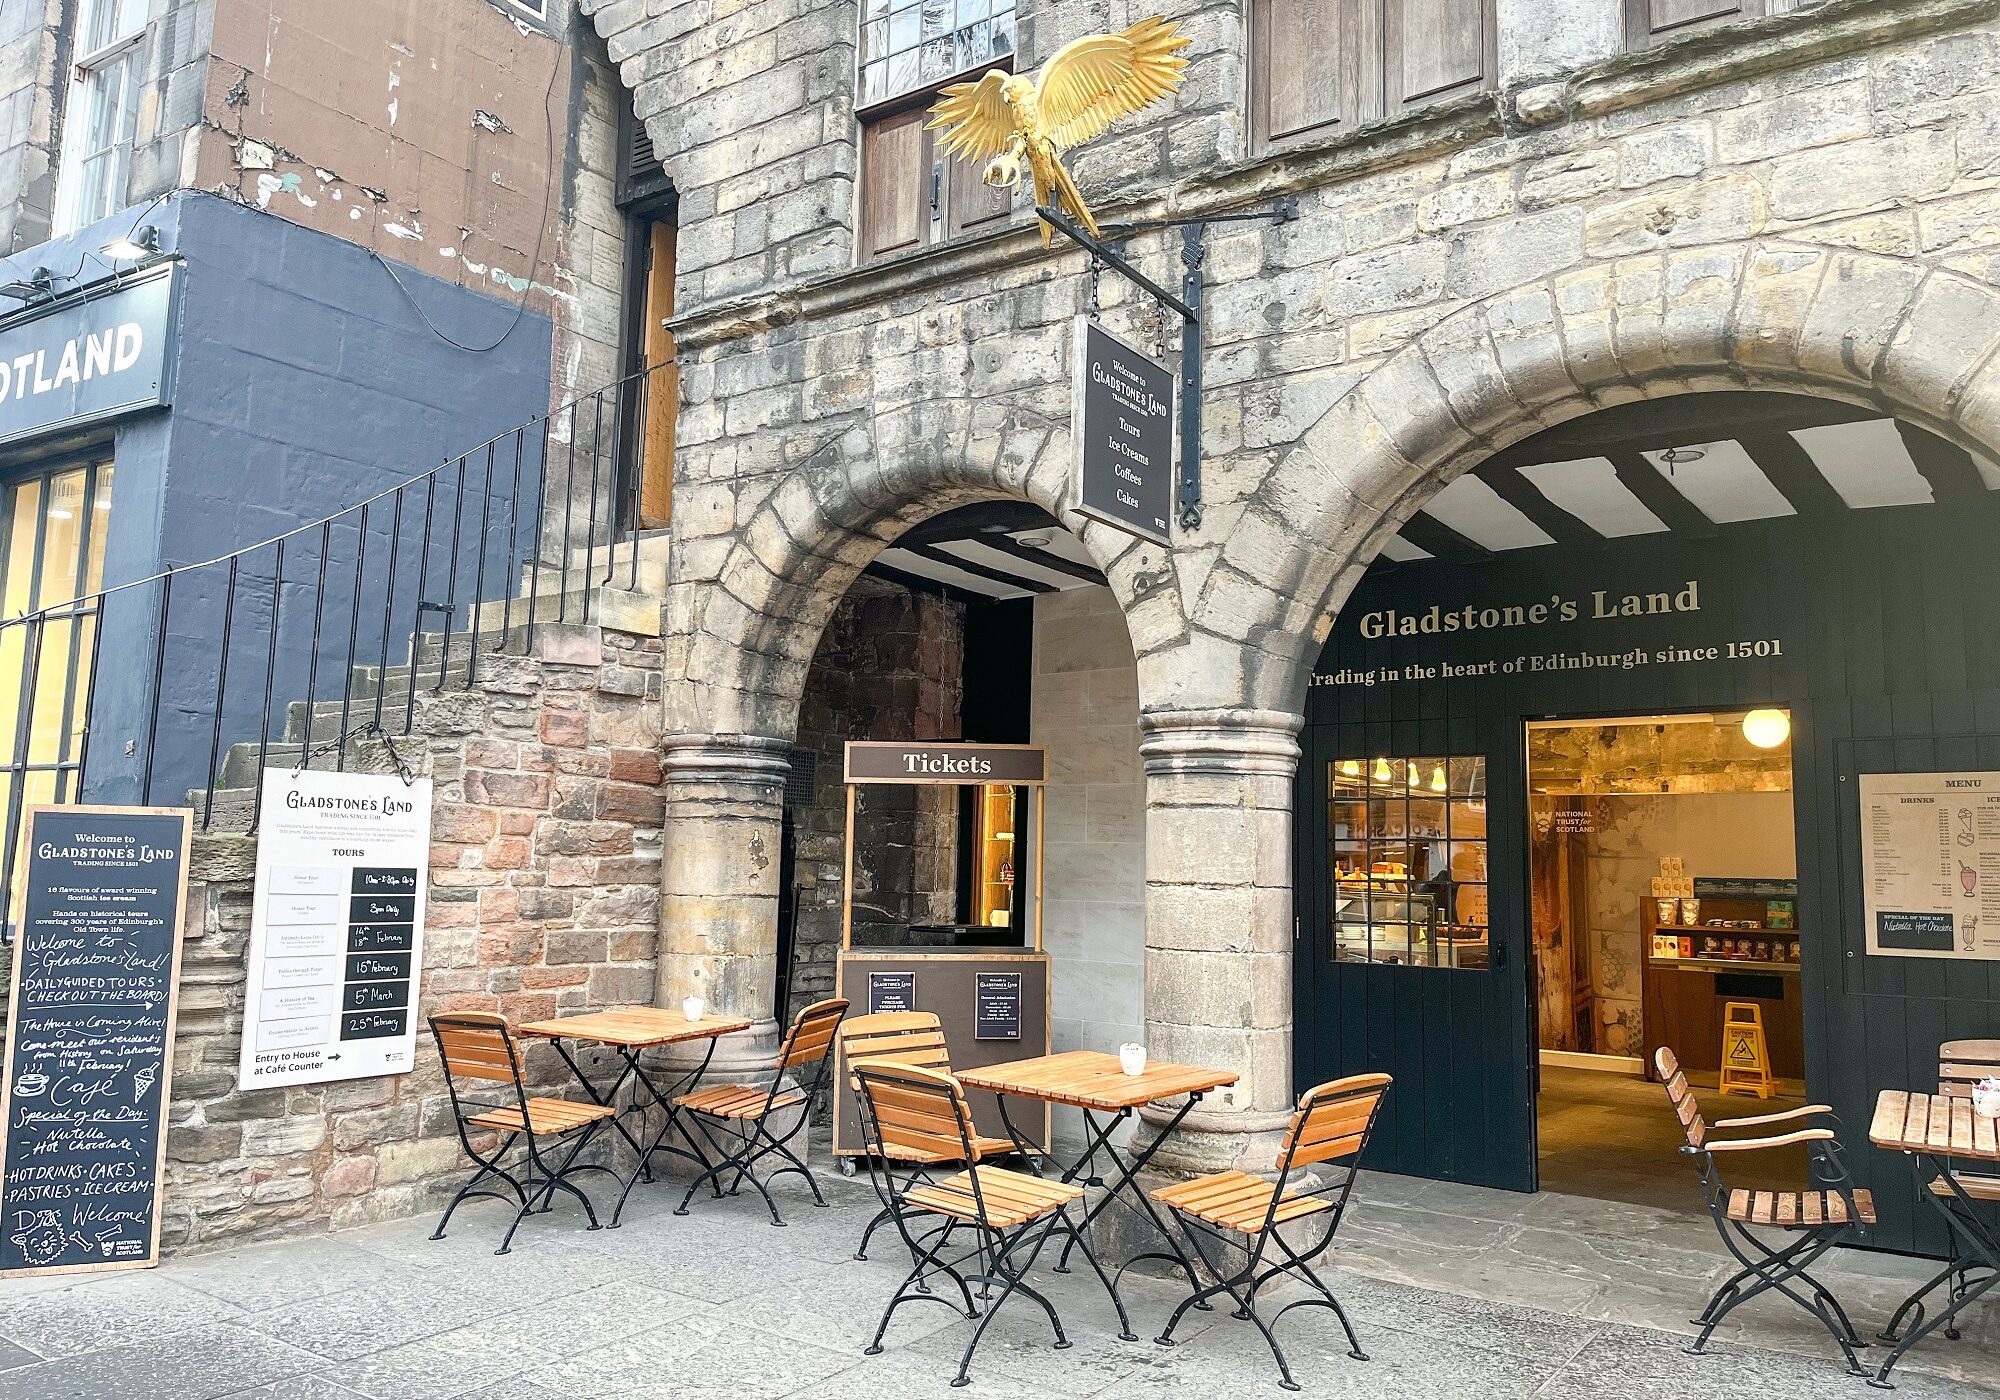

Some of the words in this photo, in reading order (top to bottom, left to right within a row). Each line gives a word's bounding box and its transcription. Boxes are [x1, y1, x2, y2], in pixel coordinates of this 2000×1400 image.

[1113, 359, 1140, 382] Welcome
[1140, 376, 1146, 386] to
[1092, 361, 1146, 406] GLADSTONE'S
[1147, 393, 1167, 417] LAND
[1118, 416, 1141, 438] Tours
[1108, 435, 1120, 452] Ice
[1121, 442, 1150, 466] Creams
[1114, 463, 1142, 486] Coffees
[1116, 488, 1139, 508] Cakes
[1359, 594, 1578, 639] Gladstone's
[1591, 580, 1701, 619] Land
[1380, 666, 1400, 682] in
[1404, 664, 1436, 681] the
[1441, 658, 1498, 678] heart
[1502, 656, 1526, 674] of
[1530, 648, 1649, 672] Edinburgh
[1656, 646, 1718, 664] since
[1726, 640, 1783, 659] 1501
[902, 752, 992, 774] Tickets
[1945, 780, 1982, 788] MENU
[286, 790, 378, 811] GLADSTONE'S
[381, 796, 413, 816] LAND
[75, 833, 122, 843] Welcome
[125, 834, 136, 843] to
[38, 842, 135, 859] GLADSTONE'S
[138, 844, 174, 863] LAND
[370, 903, 384, 914] 3pm
[1884, 920, 1913, 931] Nutella
[1915, 921, 1927, 934] Hot
[1928, 921, 1953, 932] Chocolate
[26, 934, 86, 952] Welcome
[95, 934, 124, 947] to
[376, 930, 402, 944] February
[42, 951, 124, 975] Gladstone's
[372, 961, 398, 975] February
[106, 977, 155, 989] TOURS
[27, 991, 70, 1002] CHECK
[71, 991, 100, 1000] OUT
[101, 991, 125, 1000] THE
[126, 990, 168, 1004] BOARD!
[371, 988, 393, 1001] March
[20, 1019, 42, 1034] The
[42, 1018, 72, 1031] House
[75, 1019, 84, 1027] is
[87, 1016, 132, 1031] Coming
[133, 1016, 166, 1030] Alive!
[374, 1016, 398, 1031] February
[21, 1040, 48, 1051] Come
[48, 1039, 86, 1049] meet
[88, 1038, 108, 1046] our
[60, 1050, 92, 1058] History
[117, 1045, 162, 1056] Saturday
[255, 1054, 279, 1063] Entry
[293, 1051, 321, 1059] House
[77, 1059, 131, 1074] February!
[254, 1067, 263, 1075] at
[266, 1064, 286, 1074] Café
[288, 1061, 323, 1072] Counter
[51, 1073, 119, 1106] Café
[14, 1107, 71, 1128] Special
[74, 1111, 90, 1126] of
[93, 1108, 111, 1120] the
[115, 1106, 149, 1120] Day:
[47, 1127, 107, 1140] Nutella
[32, 1140, 59, 1155] Hot
[68, 1138, 133, 1150] Chocolate
[9, 1167, 36, 1183] HOT
[36, 1164, 82, 1180] DRINKS
[89, 1162, 136, 1180] CAKES
[10, 1184, 71, 1203] PASTRIES
[82, 1182, 104, 1196] ICE
[104, 1180, 150, 1195] CREAM
[12, 1209, 61, 1231] Dogs
[72, 1200, 151, 1226] Welcome!
